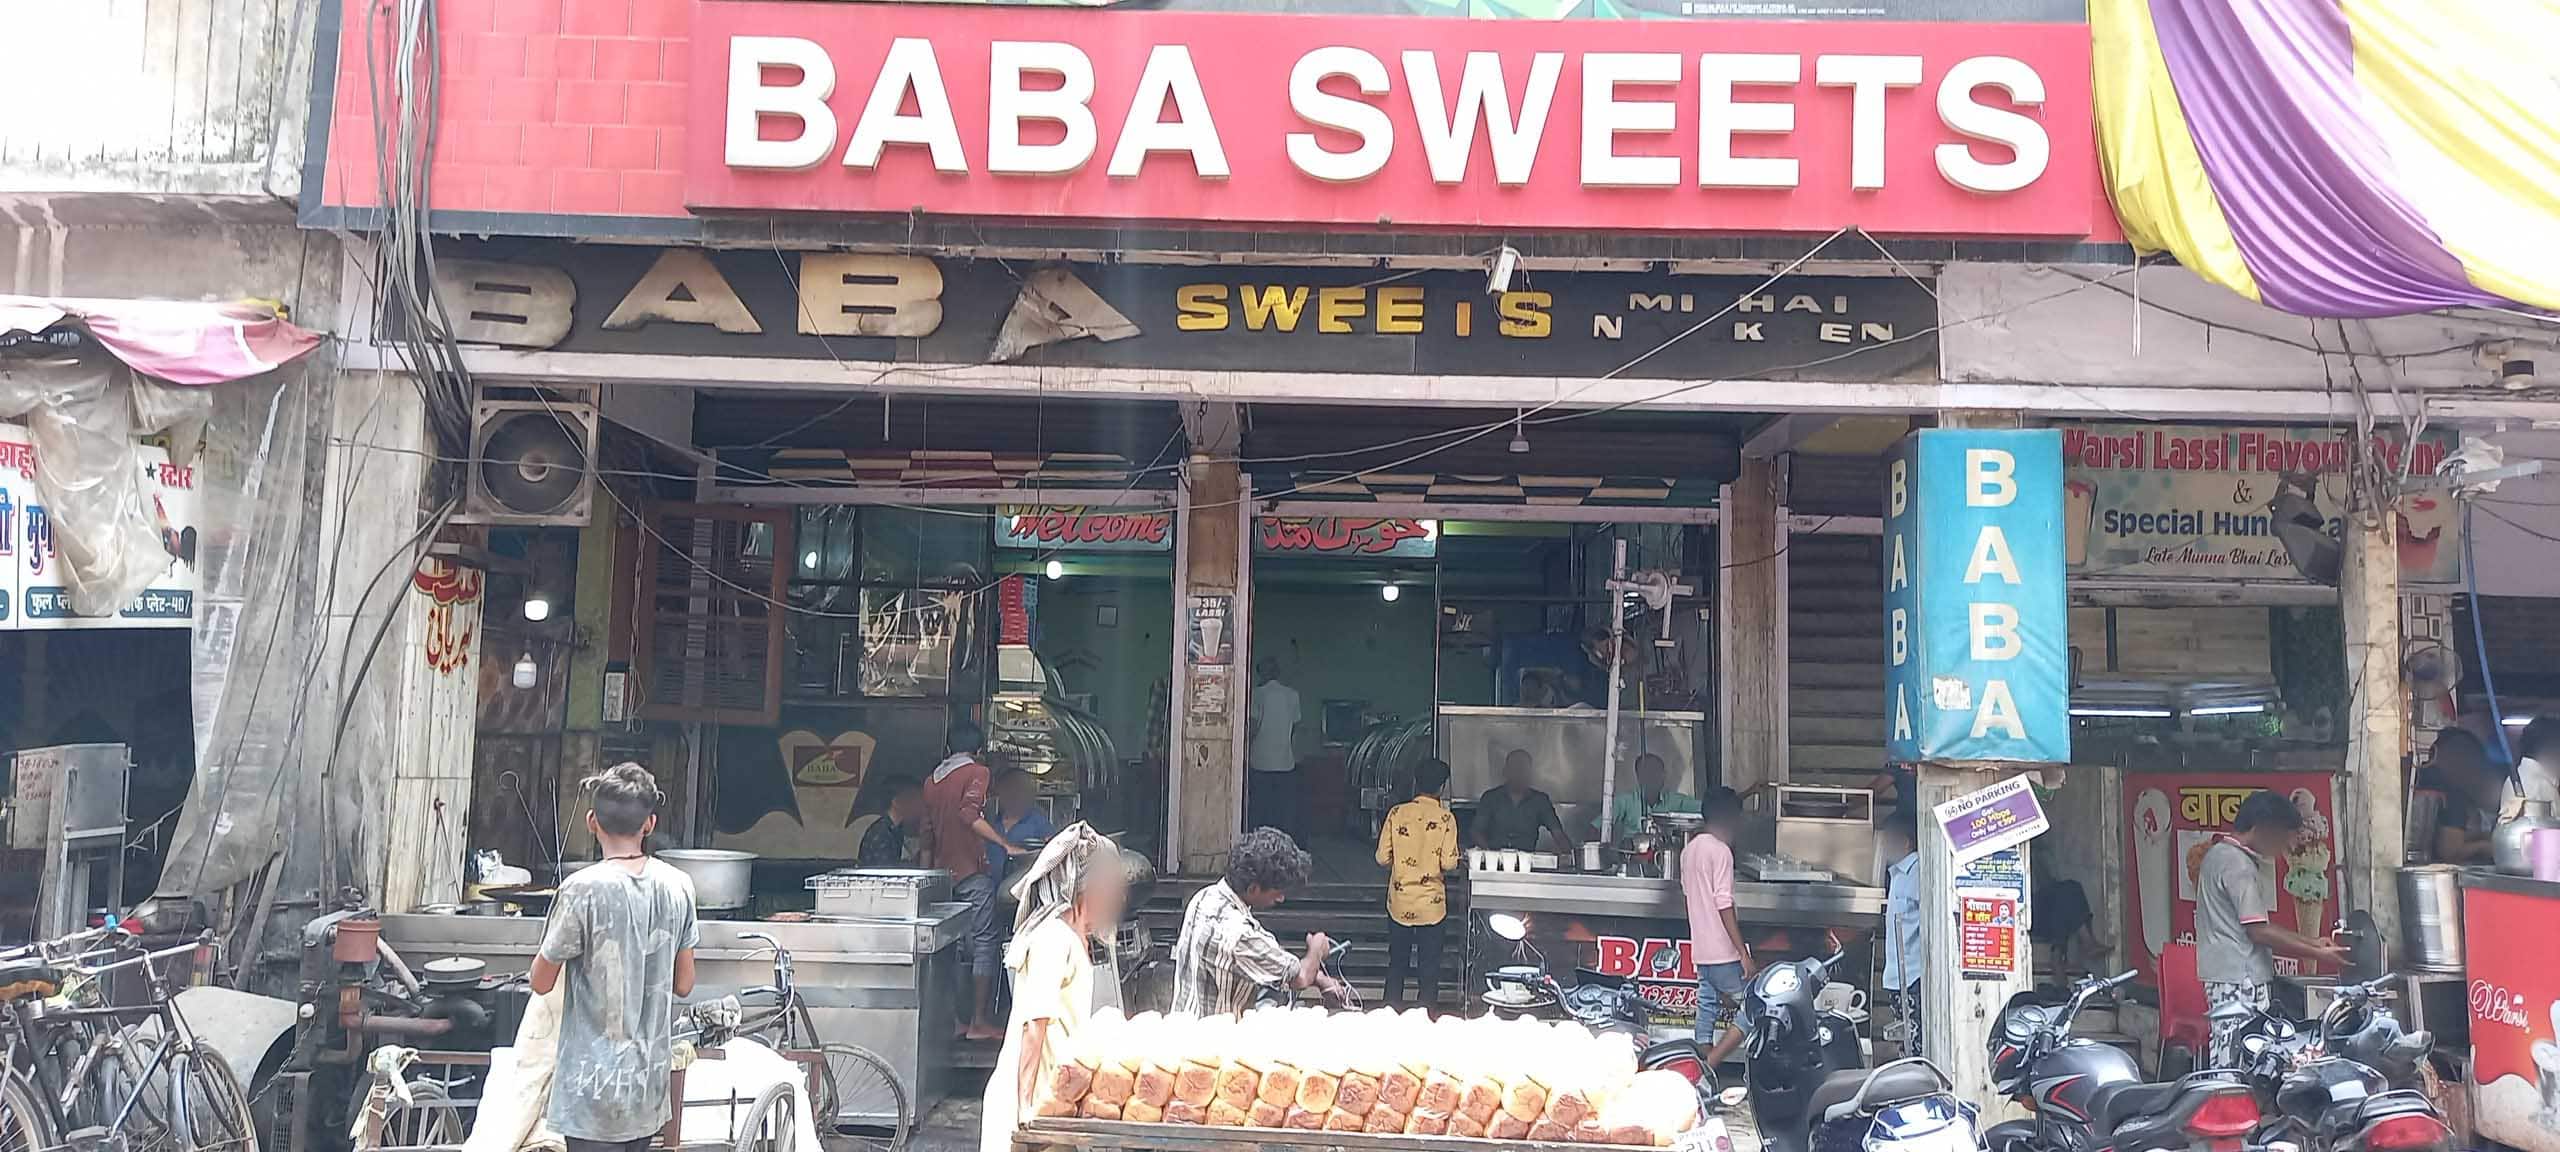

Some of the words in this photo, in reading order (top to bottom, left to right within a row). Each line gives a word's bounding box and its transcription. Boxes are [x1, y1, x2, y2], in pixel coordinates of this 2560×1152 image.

[724, 35, 1230, 180] BABA
[1285, 45, 2050, 193] SWEETS
[428, 247, 1142, 363] BABA
[2152, 429, 2230, 472] Lassi
[2104, 509, 2203, 538] Special
[2144, 546, 2174, 565] Late
[2175, 547, 2225, 565] Munna
[2229, 547, 2262, 566] Bhai
[1890, 458, 1912, 741] BABA
[1962, 448, 2026, 740] BABA
[1958, 800, 1974, 813] NO
[1975, 780, 2021, 806] PARKING
